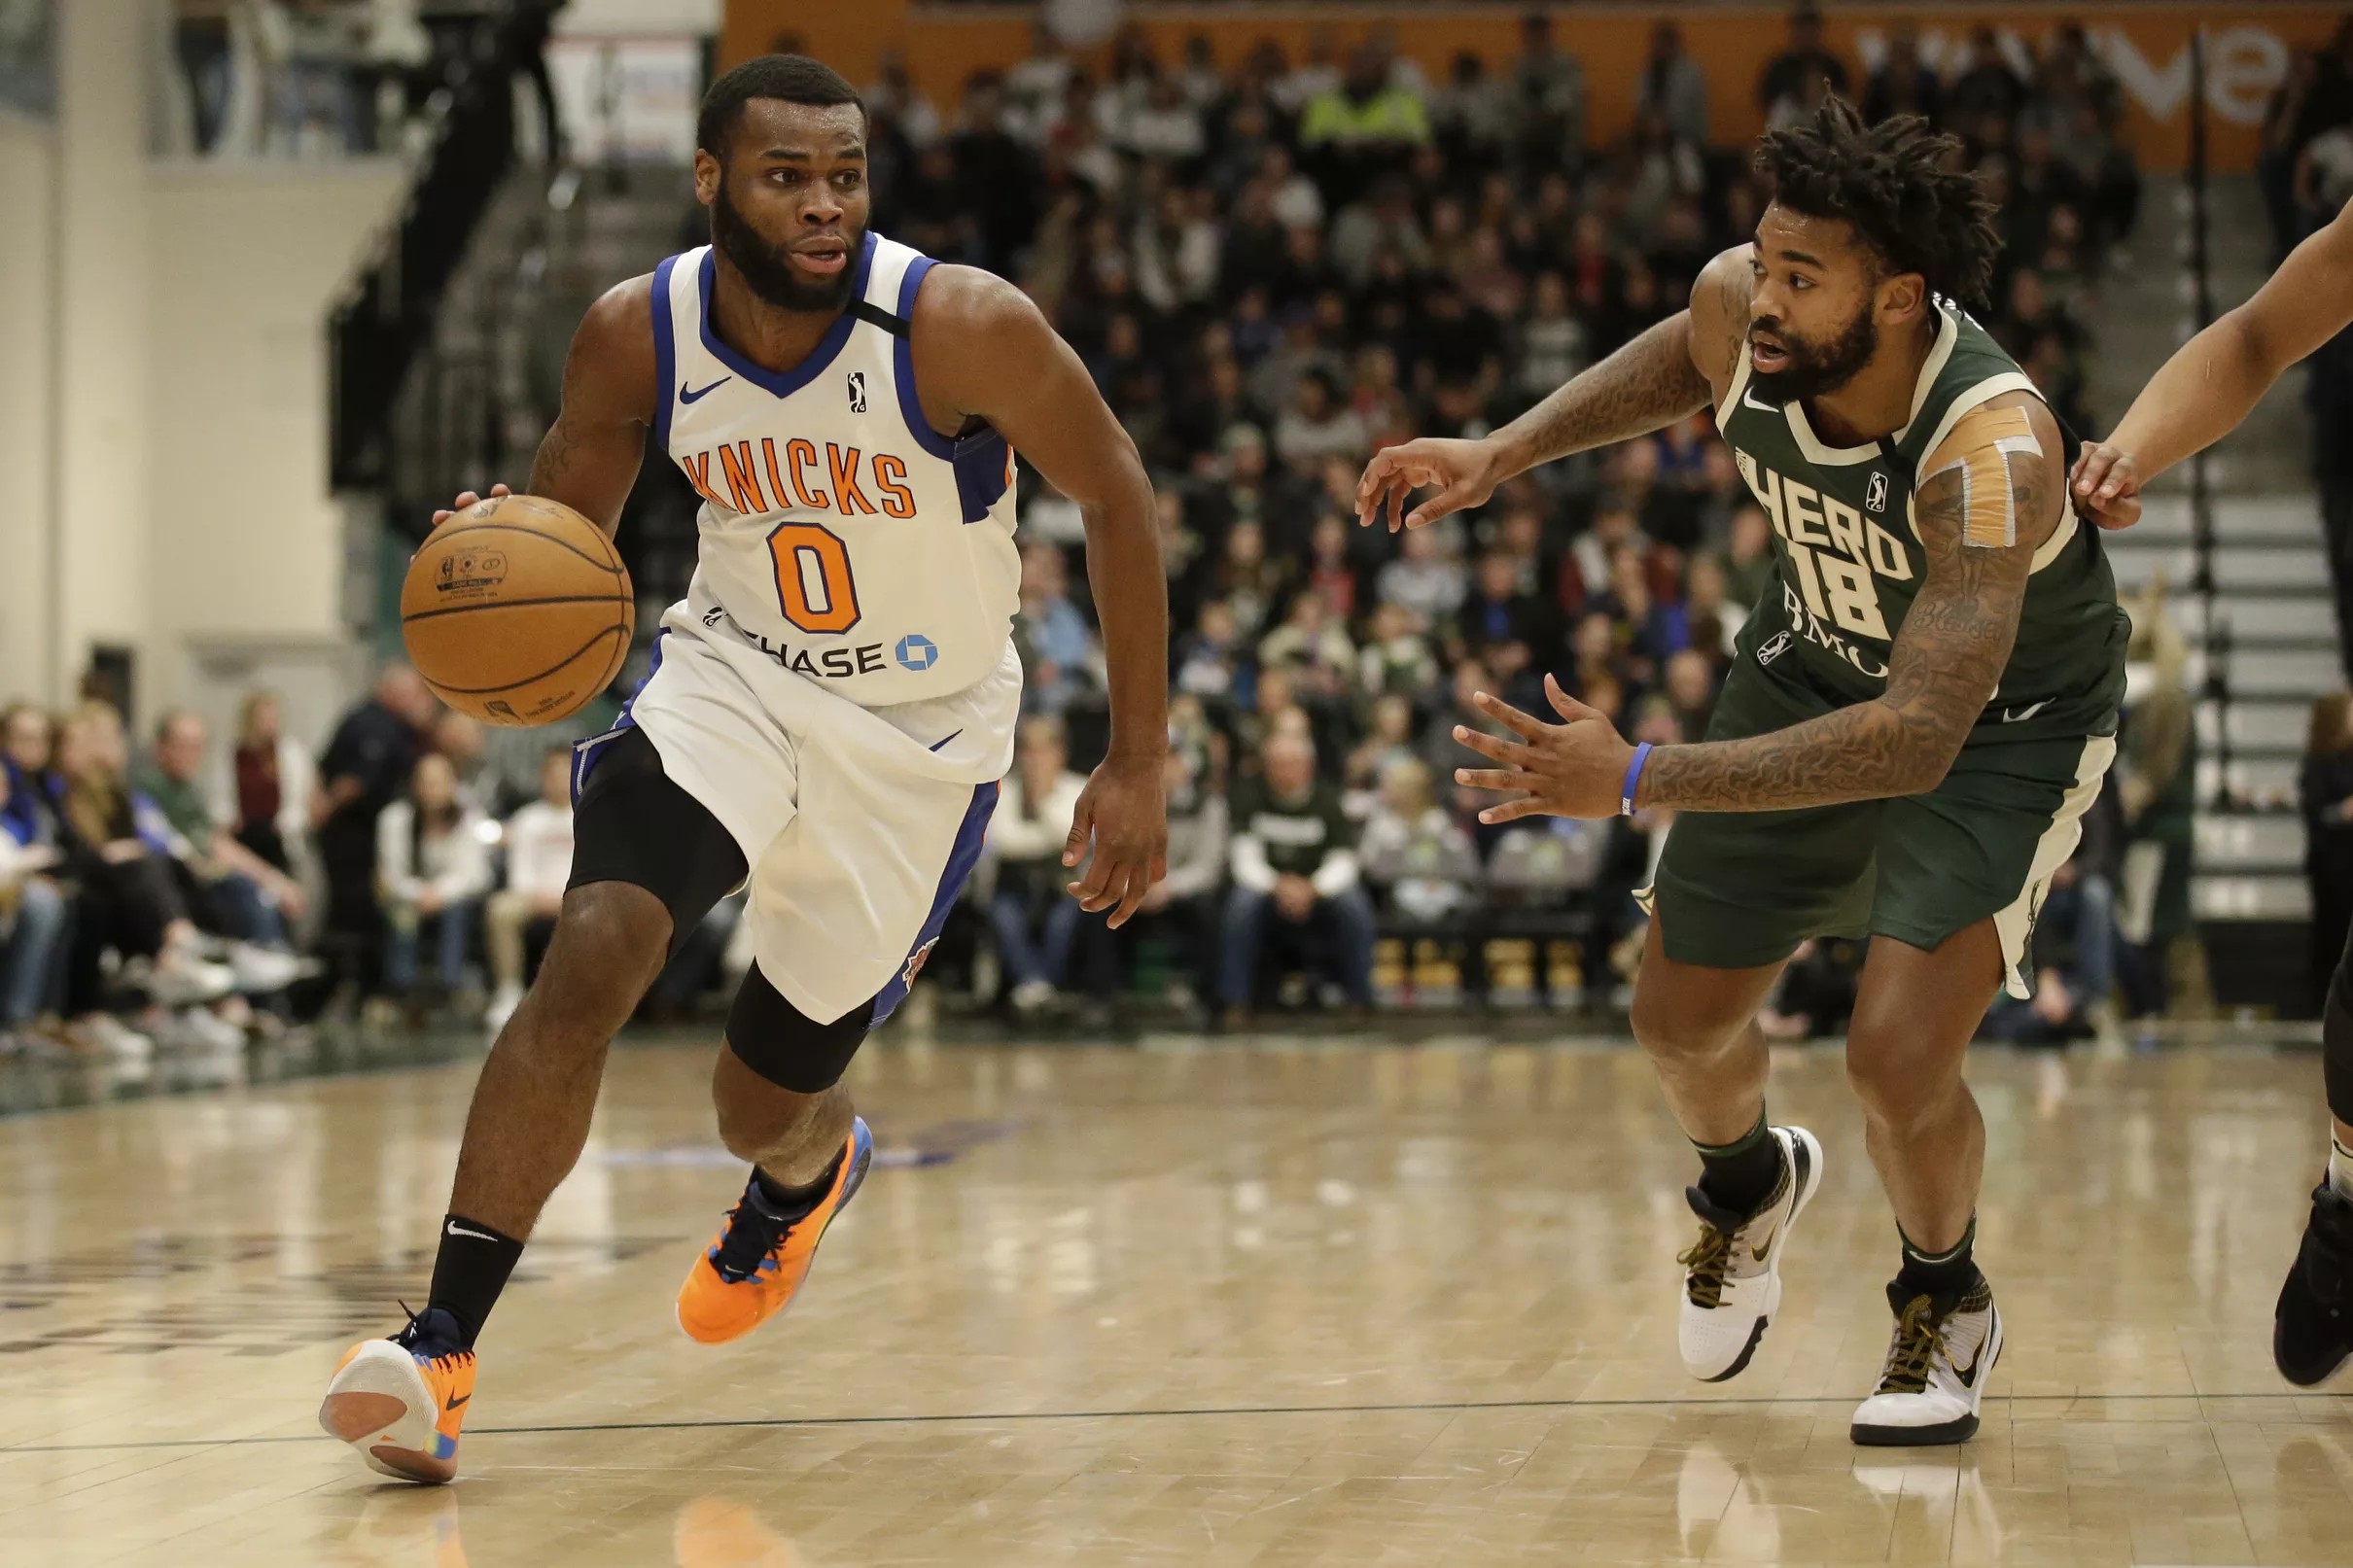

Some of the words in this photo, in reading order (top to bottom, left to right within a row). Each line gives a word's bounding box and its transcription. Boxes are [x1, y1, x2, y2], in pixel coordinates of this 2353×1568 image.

[682, 437, 917, 519] KNICKS
[766, 521, 861, 635] 0
[1786, 538, 1892, 642] 18
[743, 629, 887, 678] HASE
